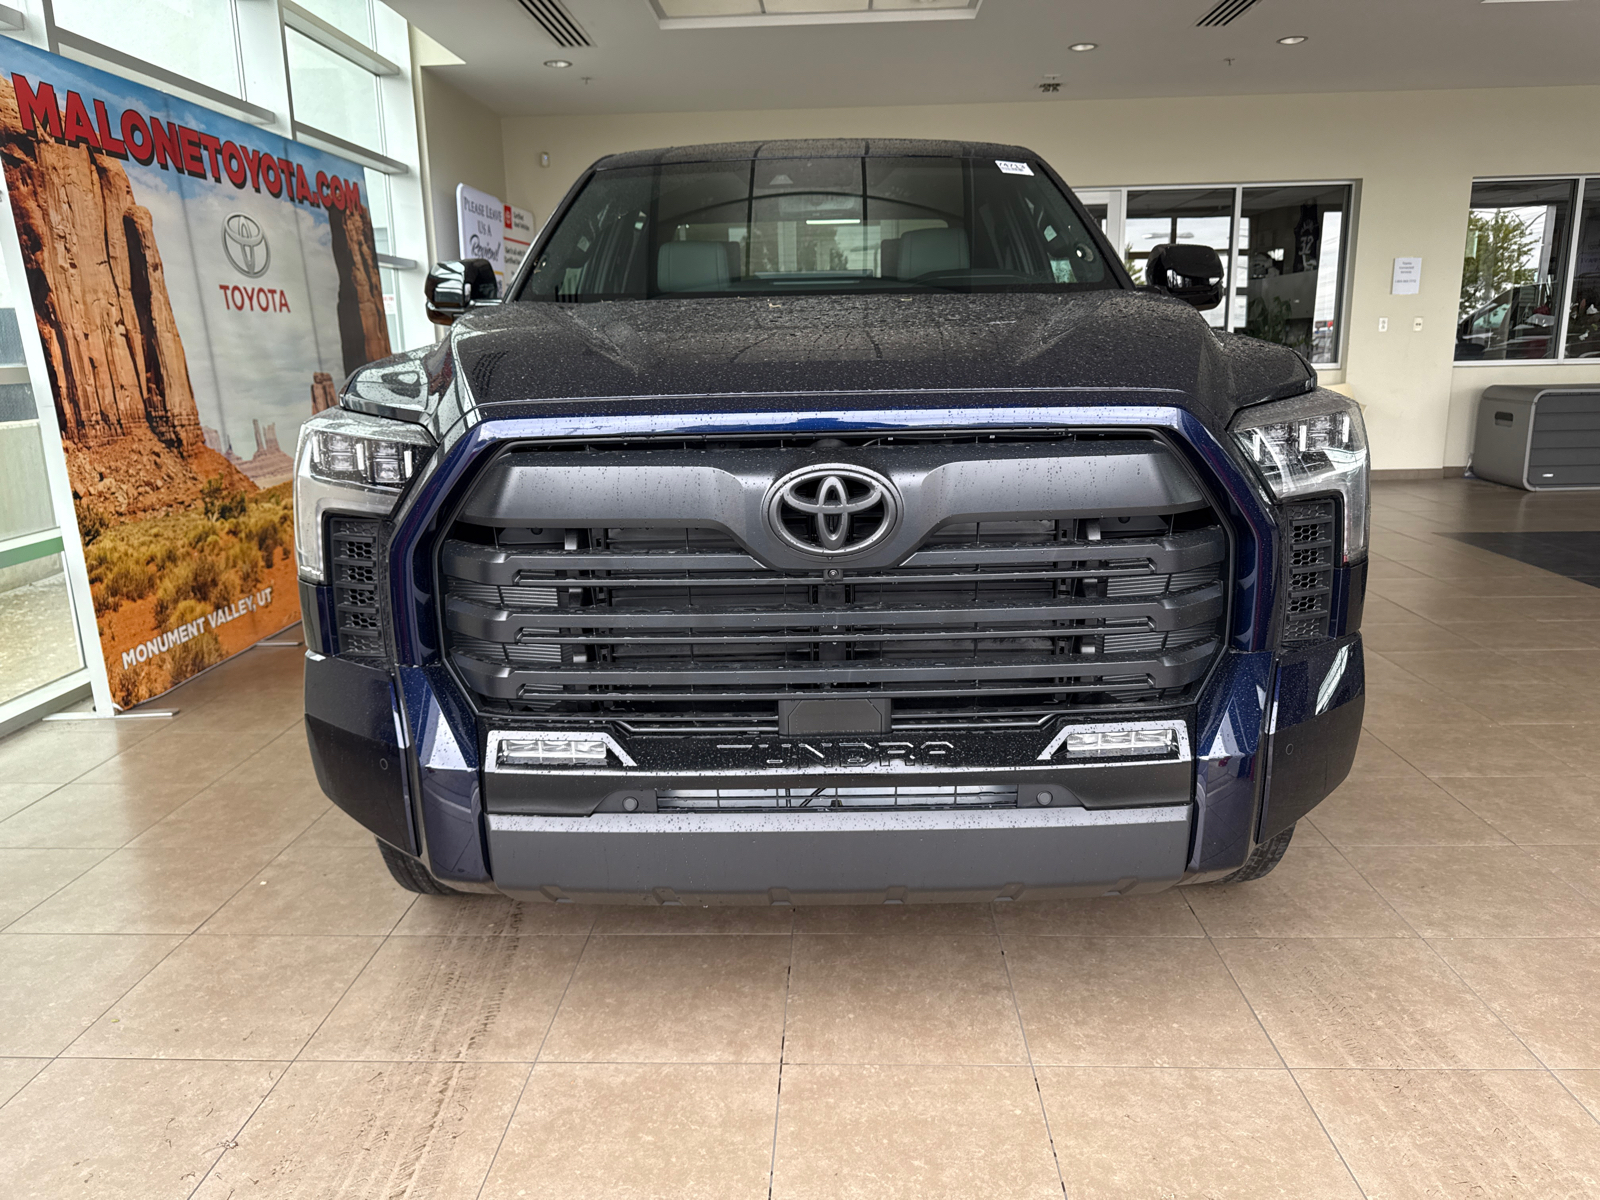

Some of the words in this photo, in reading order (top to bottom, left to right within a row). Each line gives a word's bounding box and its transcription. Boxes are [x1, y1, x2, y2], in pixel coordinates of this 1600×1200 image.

[11, 72, 362, 214] MALONETOYOTA.COM
[464, 196, 485, 217] PLEASE
[485, 203, 502, 223] LEAVE
[487, 224, 492, 237] A
[219, 284, 291, 313] TOYOTA
[121, 617, 206, 670] MONUMENT
[207, 595, 257, 629] VALLEY,
[256, 587, 273, 607] UT
[716, 741, 955, 768] TUNDRA
